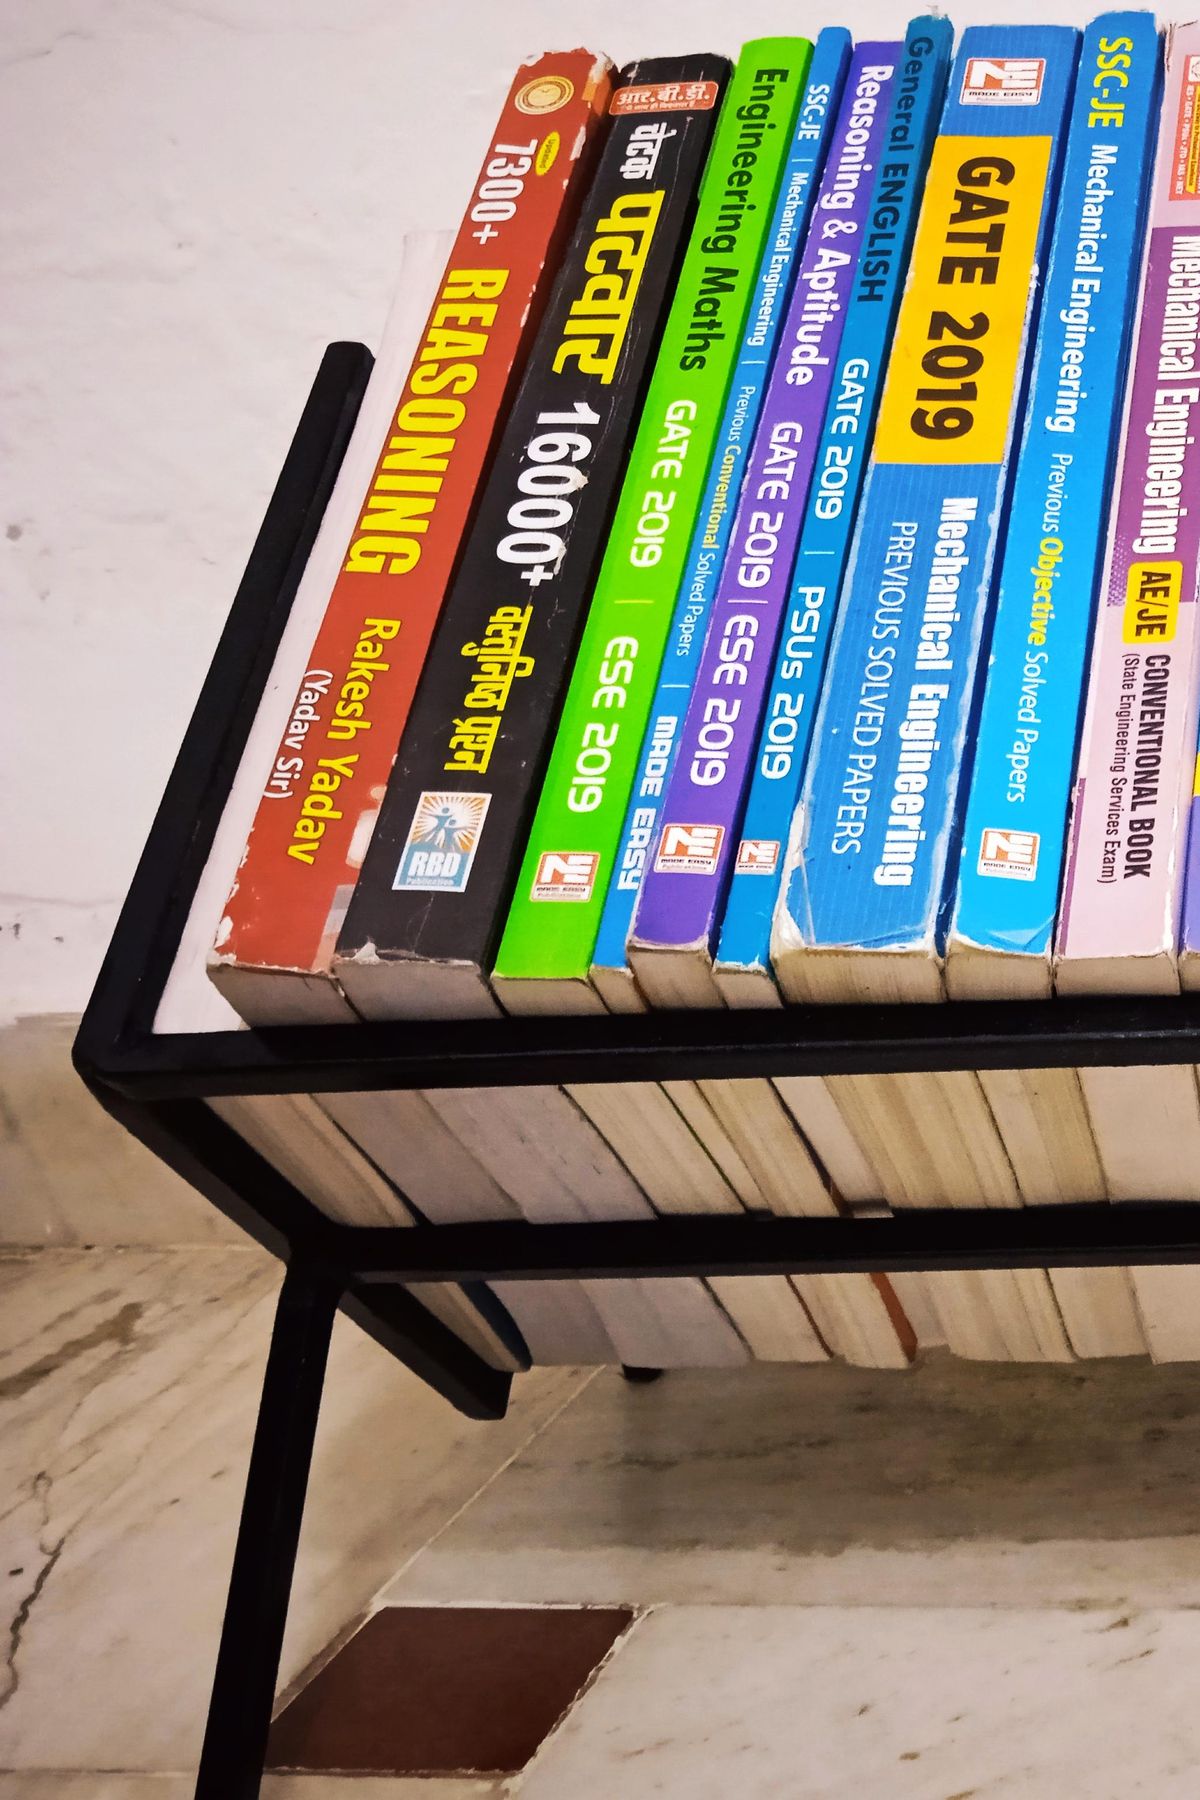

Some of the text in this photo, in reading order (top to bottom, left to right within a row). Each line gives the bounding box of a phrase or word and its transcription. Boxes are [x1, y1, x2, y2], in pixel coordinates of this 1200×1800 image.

[620, 122, 677, 180] चेटक
[937, 156, 1015, 285] GATE
[345, 138, 538, 575] 7300+ REASONING
[552, 190, 665, 384] पटवार
[910, 310, 990, 440] 2019
[496, 402, 600, 586] 16000+
[567, 68, 790, 813] Engineering Maths GATE 2019 ESE 2019
[617, 84, 830, 890] SSC-JE Mechanical Engineering Previous Conventional Solved Papers MADE EASY
[690, 64, 895, 786] Reasoning & Aptitude GATE 2019 ESE 2019
[760, 36, 934, 780] General ENGLISH GATE 2019 PSUs 2019
[1006, 37, 1133, 803] SSC-JE Mechanical Engineering Previous Objective Solved Papers
[1132, 387, 1200, 554] Engineering
[832, 520, 918, 855] PREVIOUS SOLVED PAPERS
[874, 497, 979, 886] Mechanical Engineering
[1134, 570, 1172, 637] AE/JE
[262, 669, 333, 798] (Yadav Sir)
[288, 617, 401, 865] Rakesh Yadav
[1097, 653, 1140, 885] (State Engineering Services Exam)
[1123, 654, 1171, 879] CONVENTIONAL BOOK
[408, 852, 461, 877] RBD
